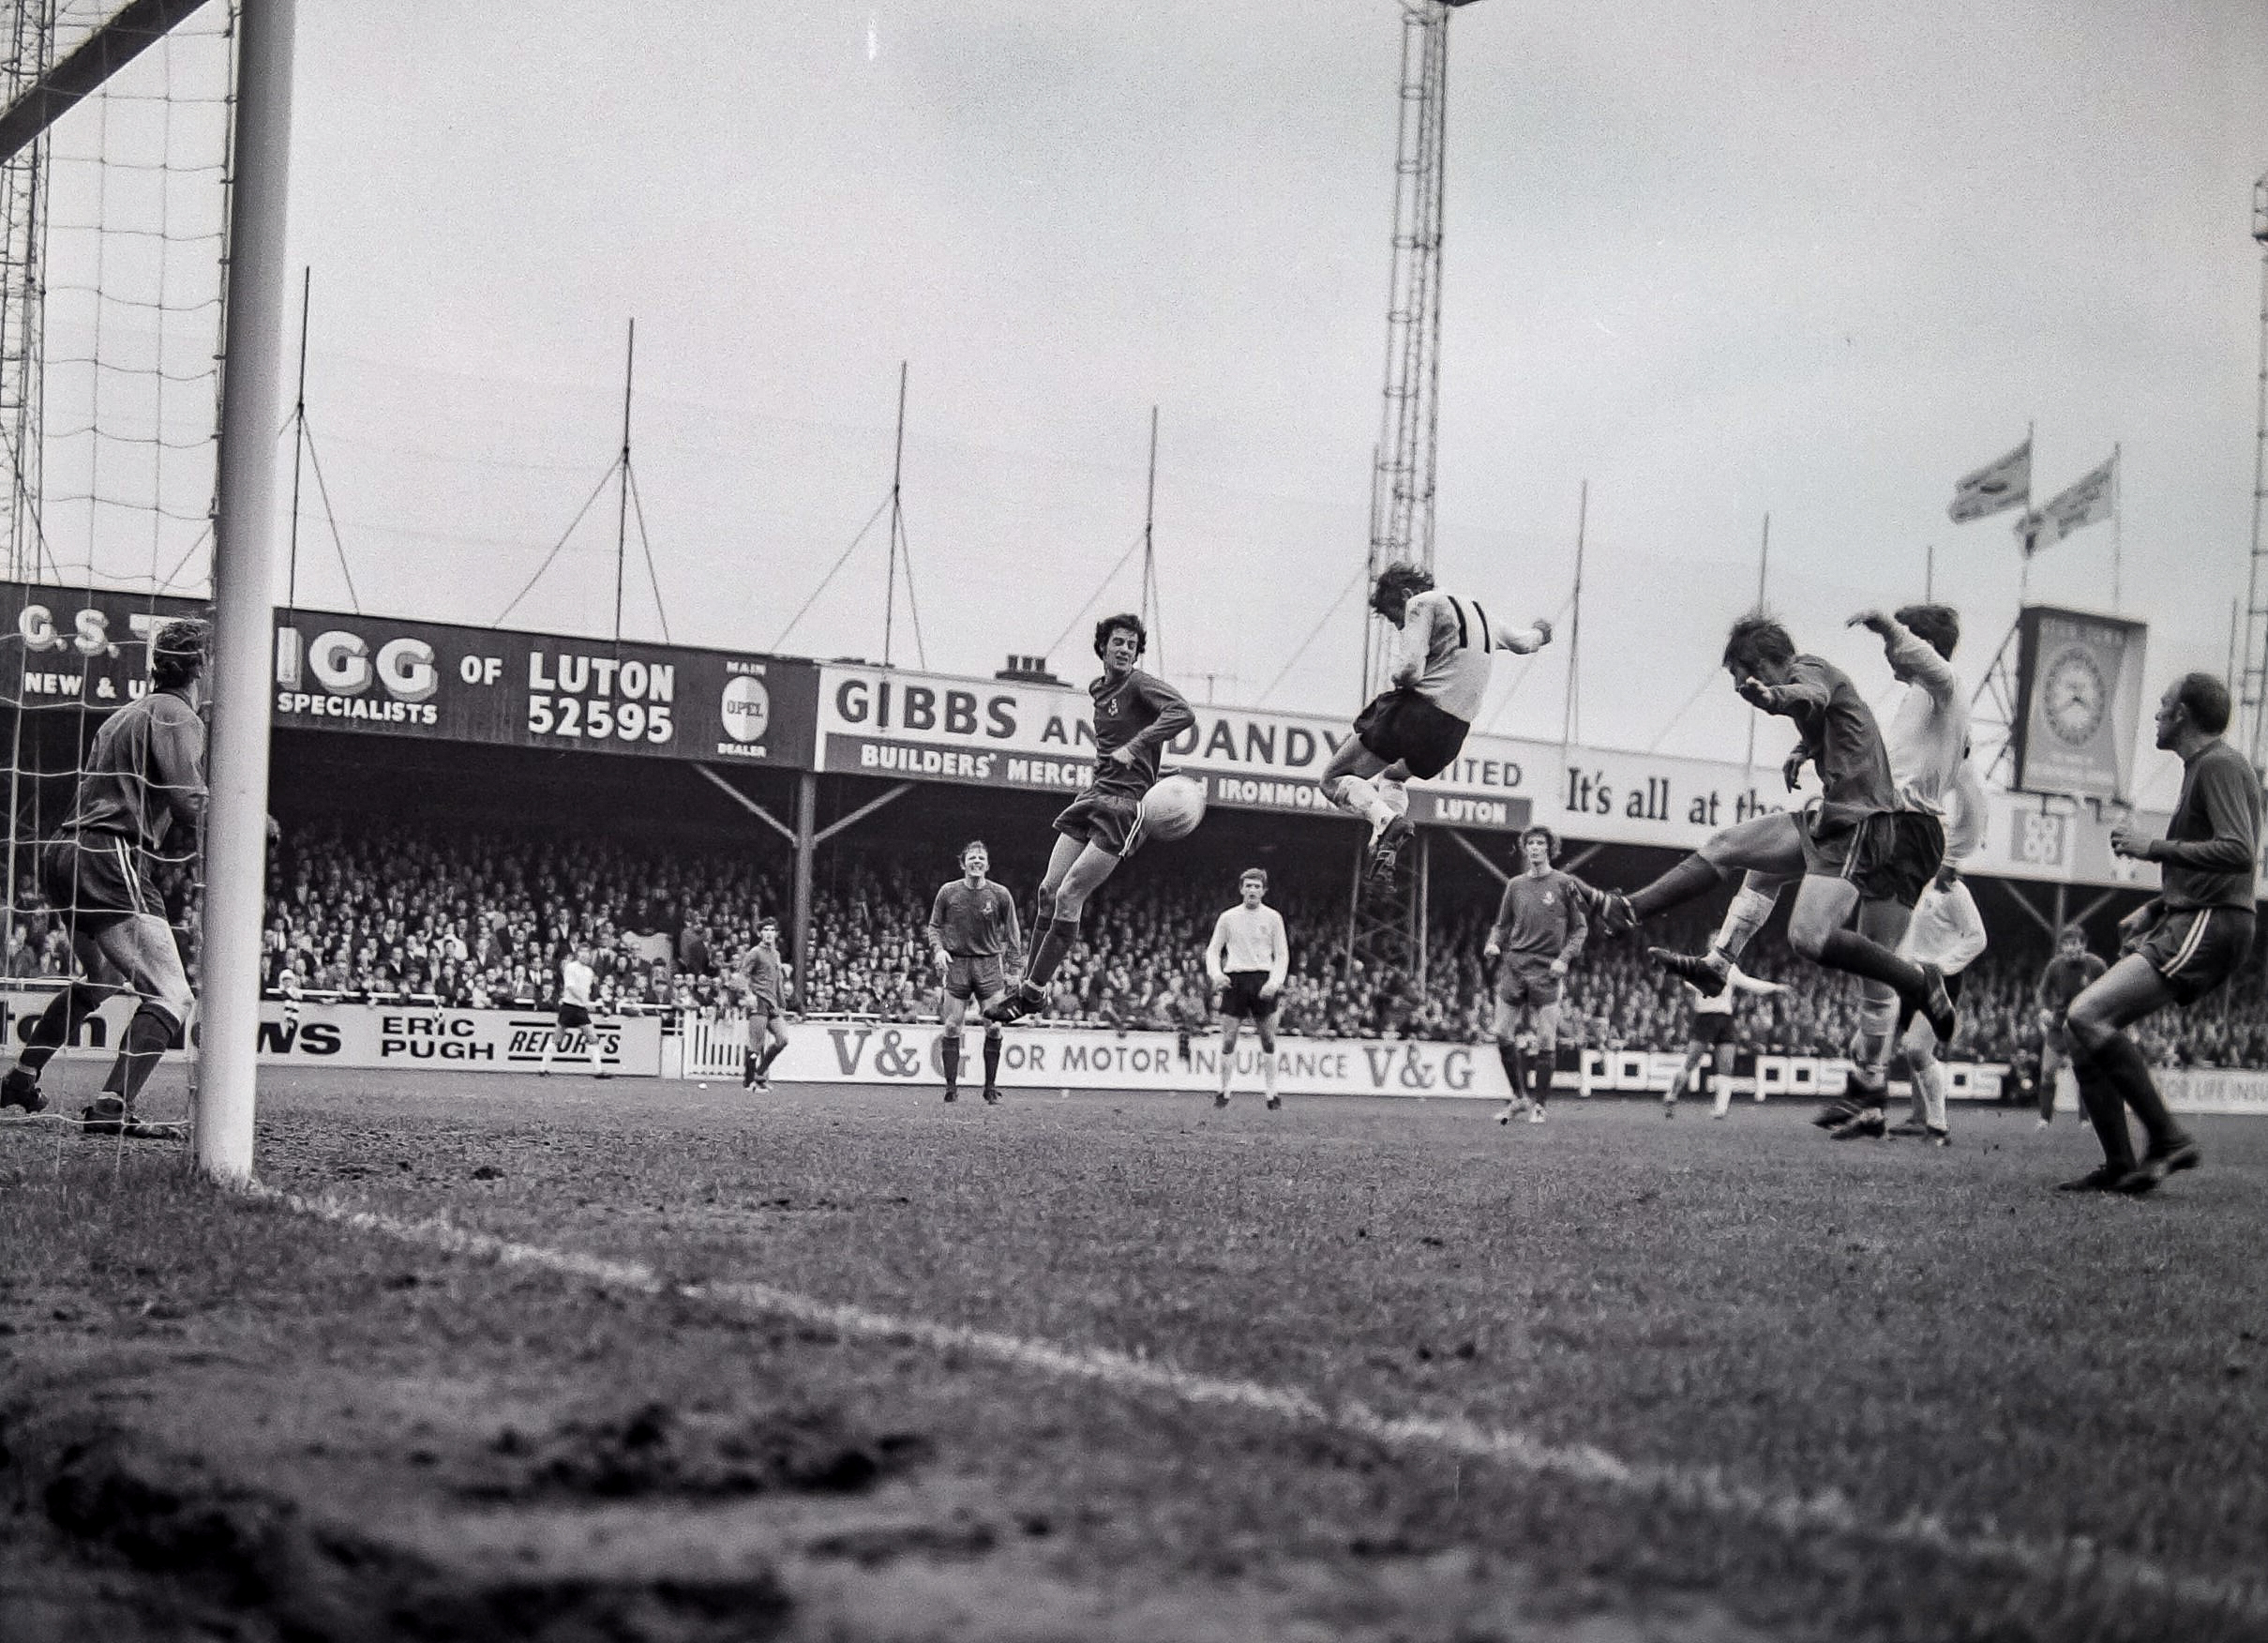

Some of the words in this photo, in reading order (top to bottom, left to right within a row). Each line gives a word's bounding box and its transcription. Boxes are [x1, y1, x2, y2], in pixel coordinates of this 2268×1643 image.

[459, 655, 503, 686] OF
[528, 651, 675, 703] LUTON
[726, 661, 767, 675] MAIN
[24, 671, 83, 696] NEW
[97, 676, 116, 699] &
[278, 692, 438, 725] SPECIALISTS
[528, 695, 674, 745] 52595
[728, 700, 764, 717] OPEL
[835, 680, 1018, 739] GIBBS
[1040, 716, 1099, 748] AN
[717, 743, 767, 758] DEALER
[1566, 767, 1612, 814] It's
[1626, 776, 1670, 821] all
[1689, 791, 1720, 826] at
[1434, 798, 1508, 825] LUTON
[383, 1017, 474, 1037] ERIC
[382, 1039, 494, 1060] PUGH
[1005, 1044, 1044, 1071] OR
[1062, 1045, 1169, 1075] MOTOR
